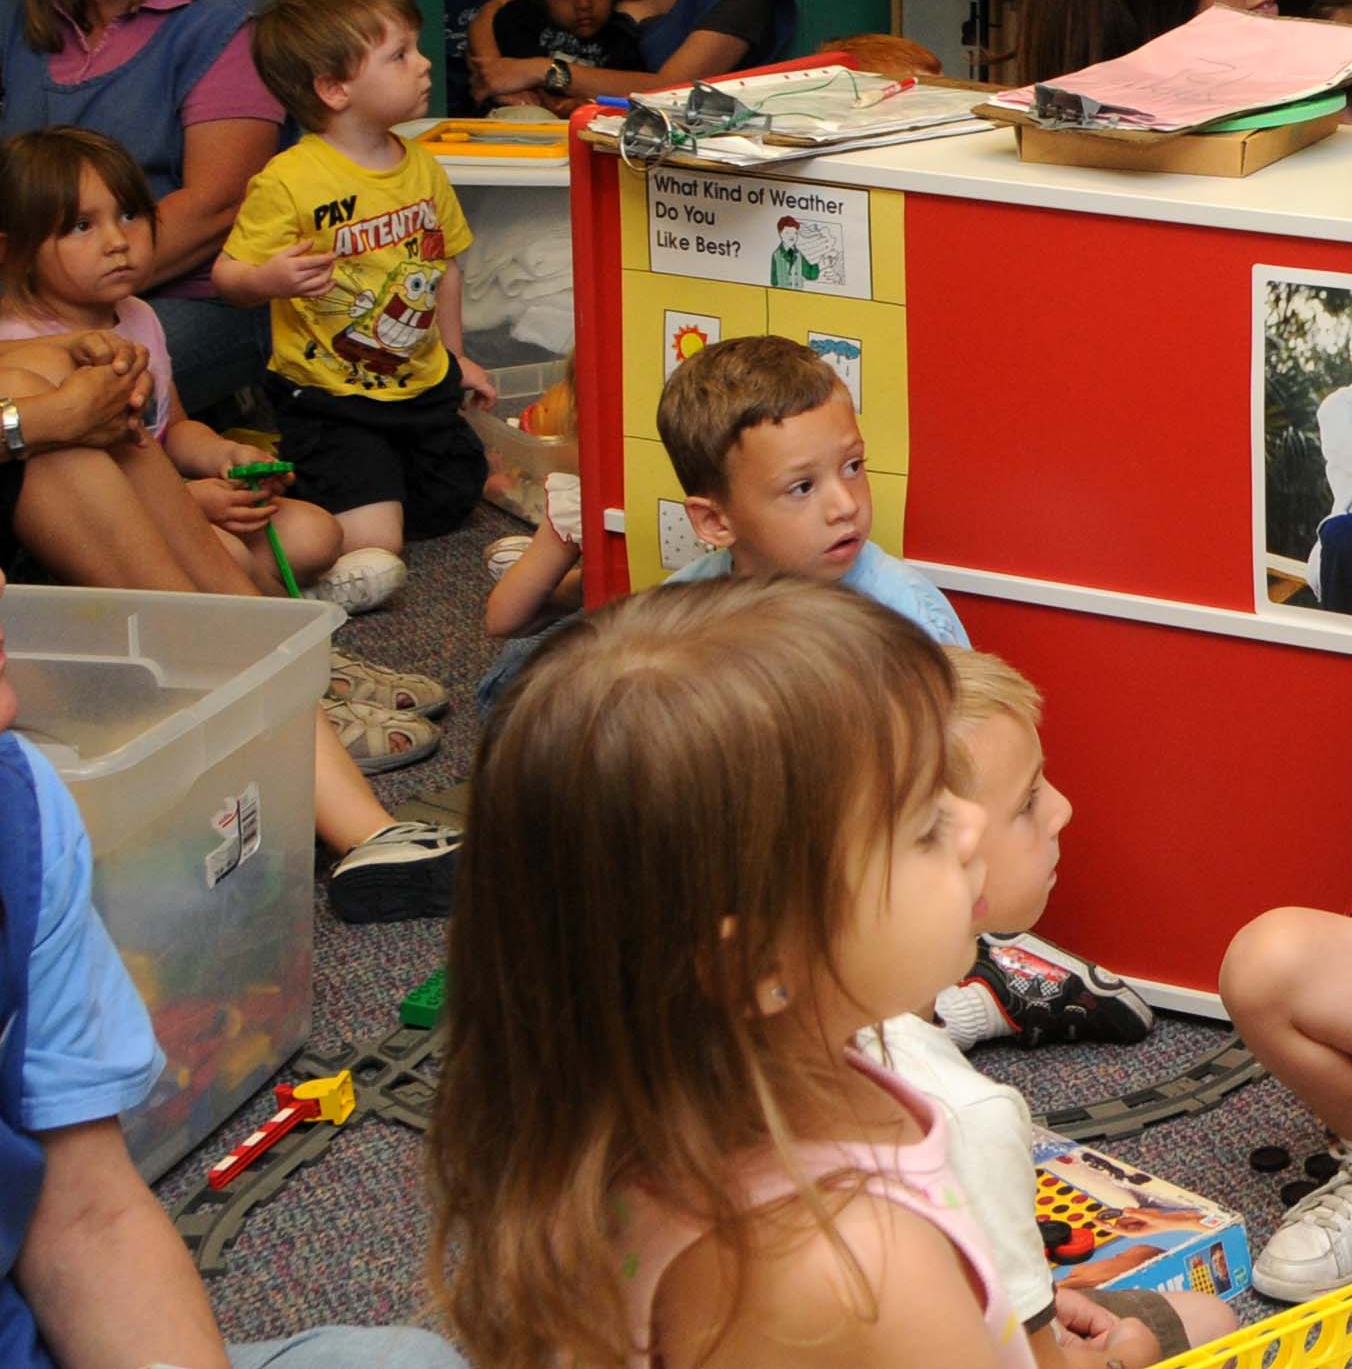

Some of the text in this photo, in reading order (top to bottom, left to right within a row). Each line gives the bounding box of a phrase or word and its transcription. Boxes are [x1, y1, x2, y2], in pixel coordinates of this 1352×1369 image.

[653, 174, 844, 215] What Kind of Weather
[314, 195, 357, 231] PAY
[655, 201, 716, 226] Do You
[404, 236, 419, 258] TO
[657, 230, 741, 258] Like Best?
